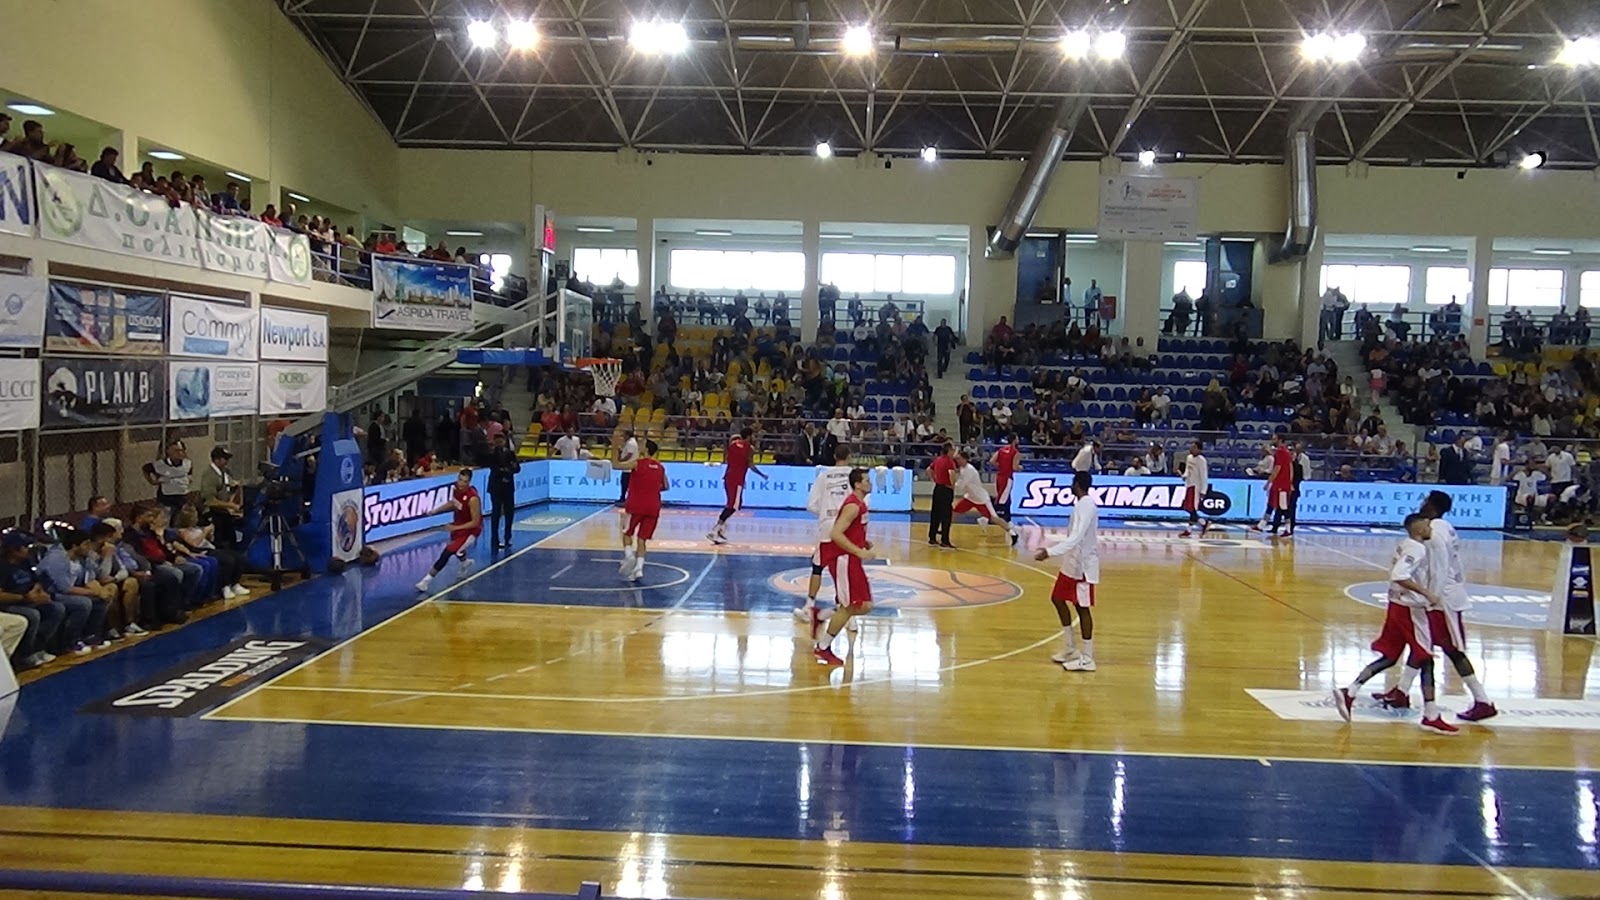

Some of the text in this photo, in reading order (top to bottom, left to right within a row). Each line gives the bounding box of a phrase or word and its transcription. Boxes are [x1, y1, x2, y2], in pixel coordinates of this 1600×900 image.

[396, 306, 472, 321] ASPIDA TRAVEL
[263, 317, 310, 351] Newport
[85, 371, 150, 404] PLAN B
[1022, 479, 1186, 508] STOXIMA
[1397, 506, 1482, 517] ΕΥΝΗΣ
[112, 640, 309, 709] SPALDING
